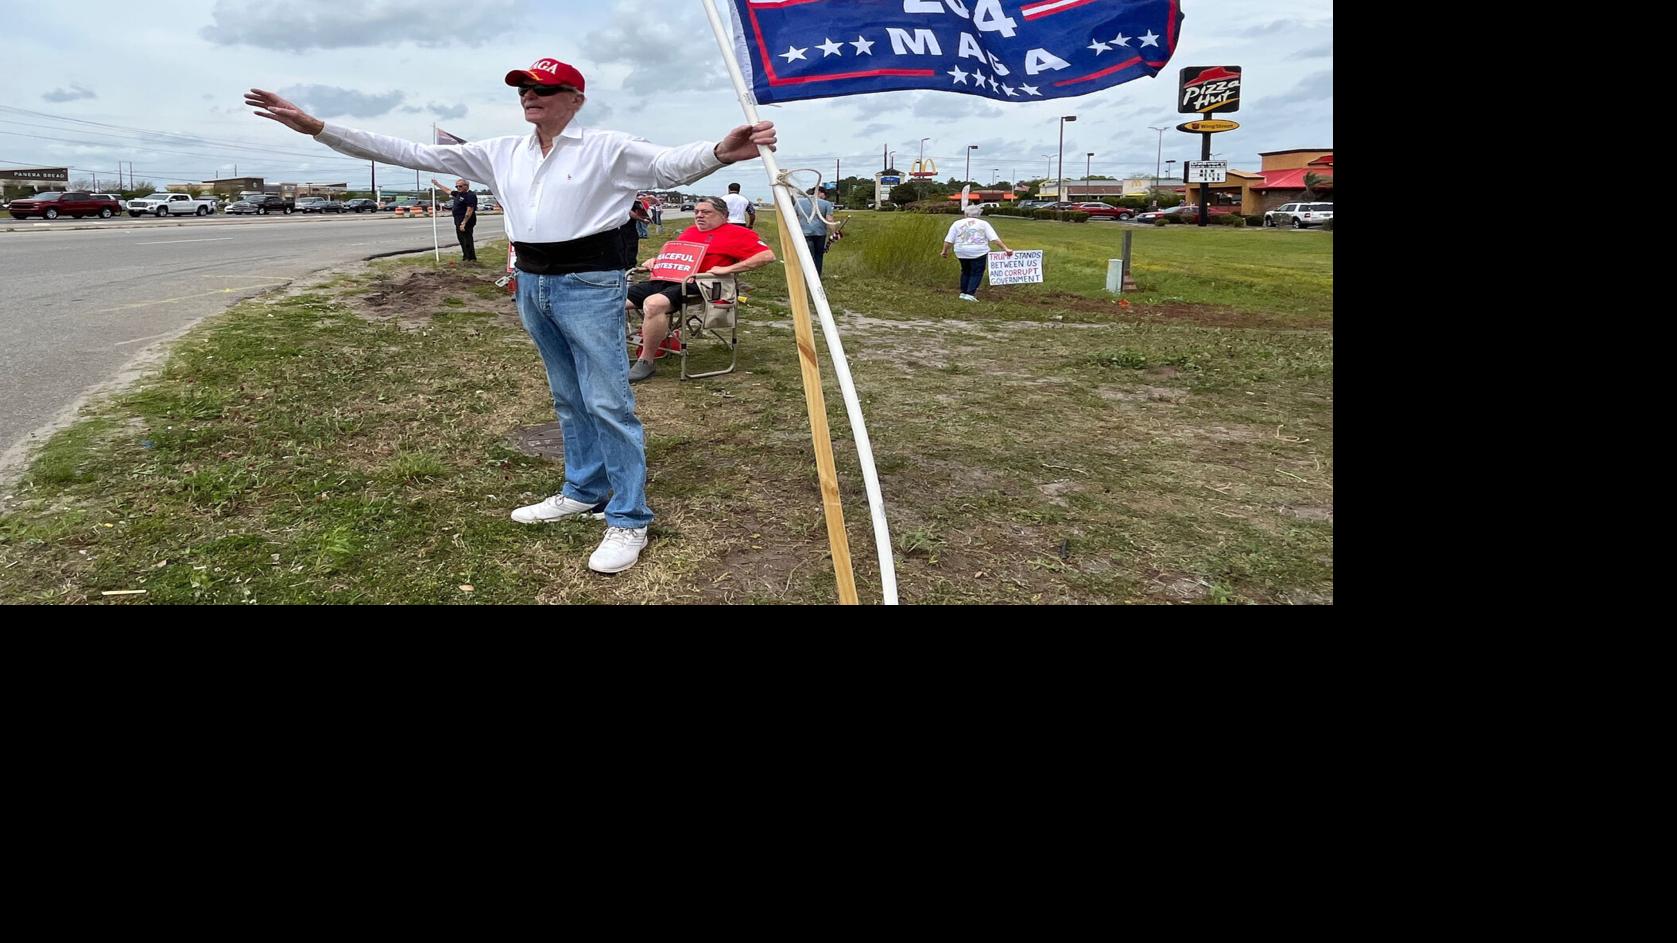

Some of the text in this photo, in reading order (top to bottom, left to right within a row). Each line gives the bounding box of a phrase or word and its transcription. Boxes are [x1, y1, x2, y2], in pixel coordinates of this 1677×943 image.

[886, 27, 1071, 76] MAGA
[531, 60, 559, 75] AGA
[1183, 80, 1240, 106] Pizza
[1193, 90, 1236, 110] Hut
[657, 253, 694, 262] EACEFUL
[991, 259, 1037, 269] BETWEEN US
[1005, 268, 1038, 277] CORRUPT
[991, 275, 1040, 284] GOVERNMENT
